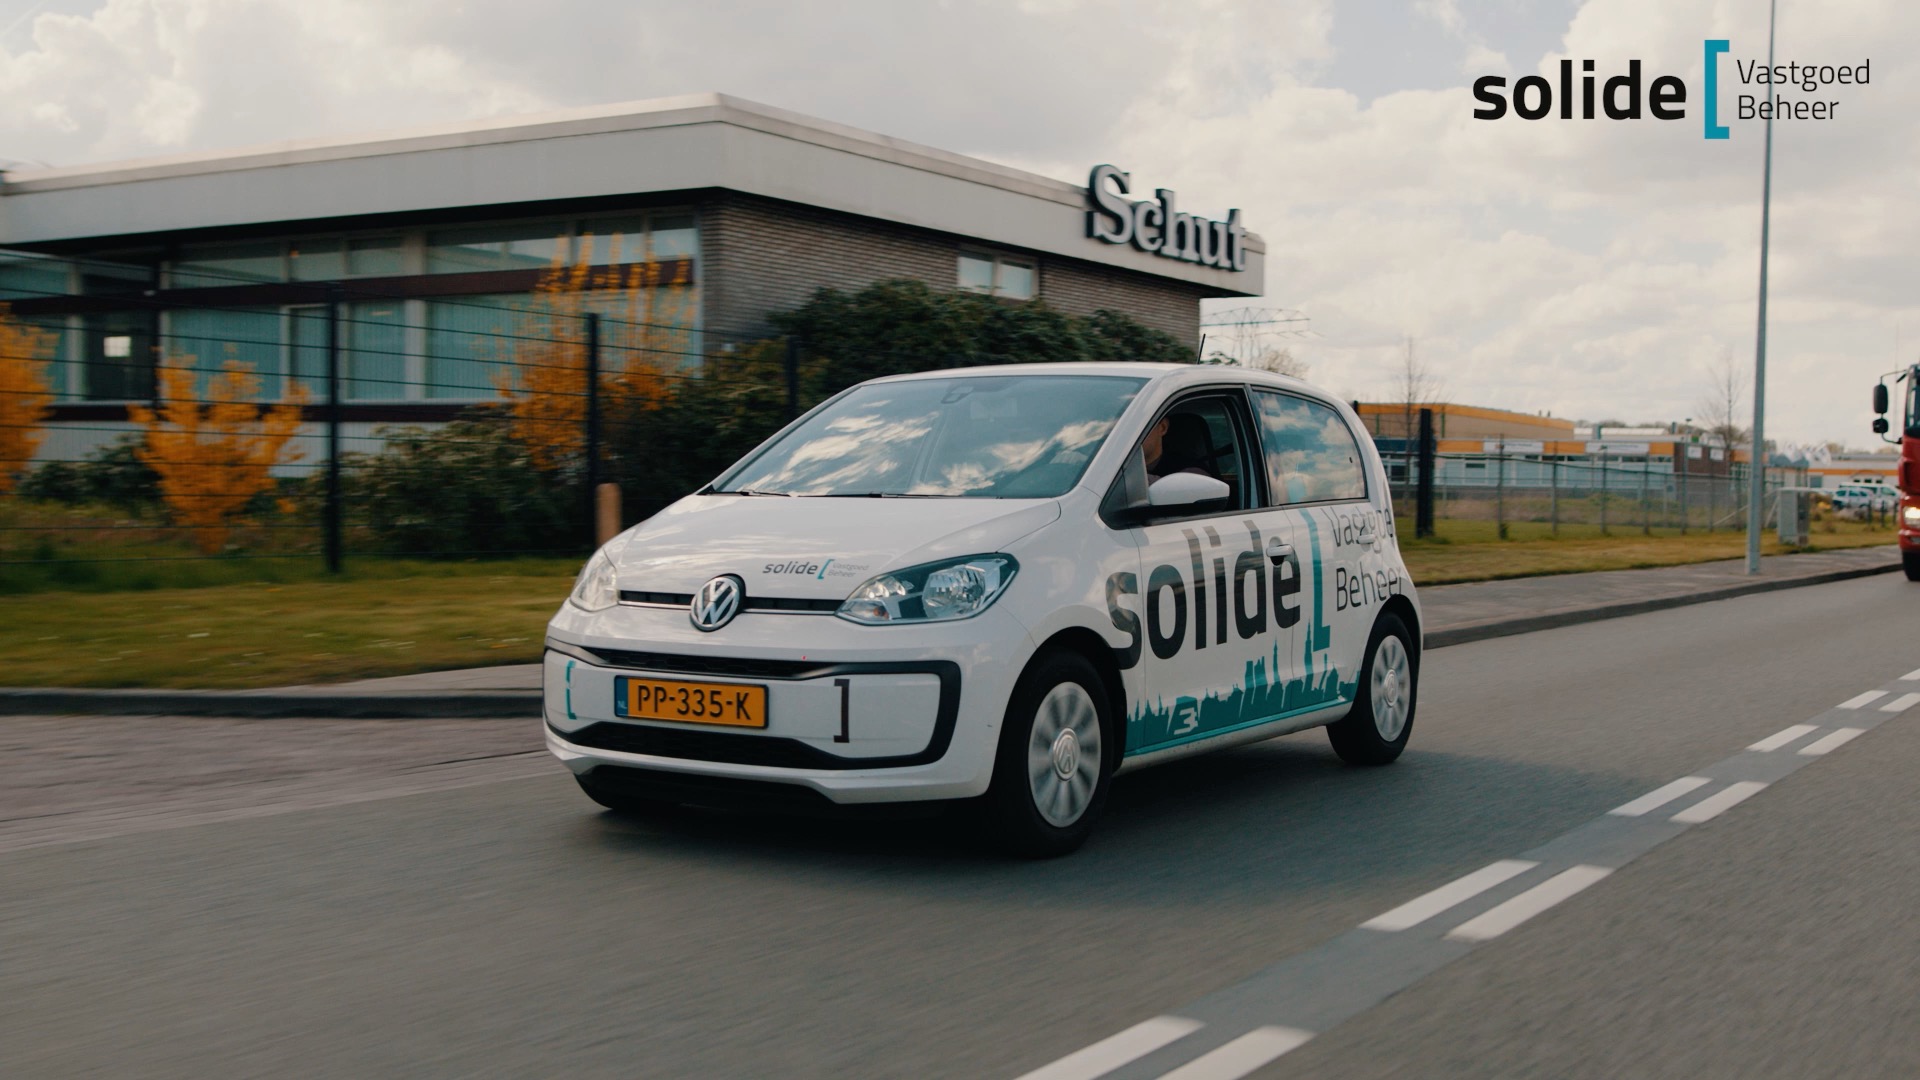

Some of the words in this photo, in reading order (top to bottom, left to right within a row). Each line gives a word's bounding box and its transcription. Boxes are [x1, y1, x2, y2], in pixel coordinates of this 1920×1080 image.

[1086, 163, 1247, 272] Schut
[762, 560, 819, 575] solide
[1105, 519, 1301, 671] solide
[638, 685, 751, 720] PP-335-K
